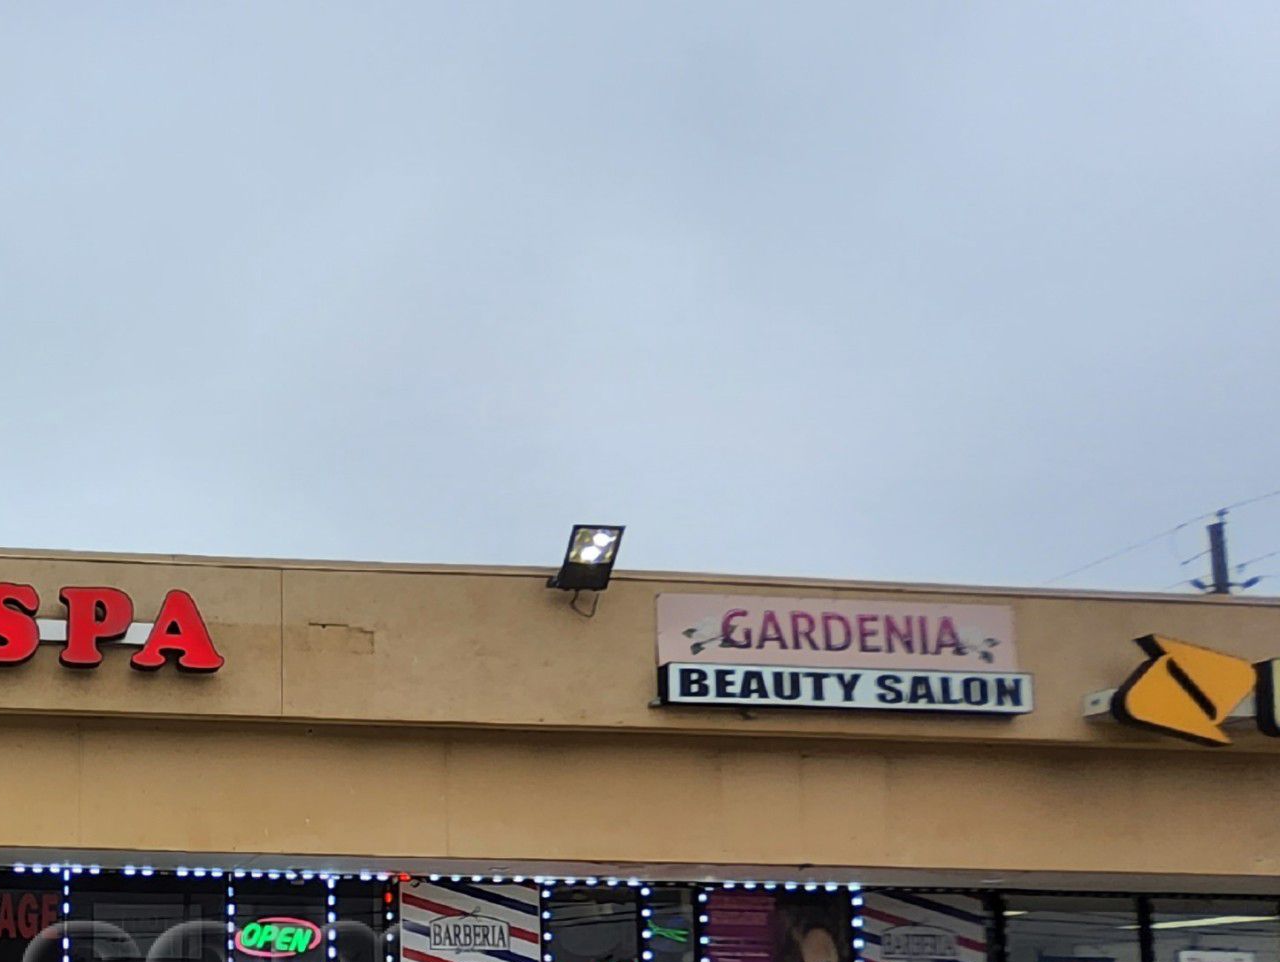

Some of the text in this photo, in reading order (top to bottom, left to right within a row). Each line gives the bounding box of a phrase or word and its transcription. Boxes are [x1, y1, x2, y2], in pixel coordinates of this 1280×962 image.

[721, 608, 961, 655] GARDENIA
[678, 668, 1024, 707] BEAUTY SALON
[241, 922, 312, 952] OPEN
[433, 923, 507, 948] BARBERIA
